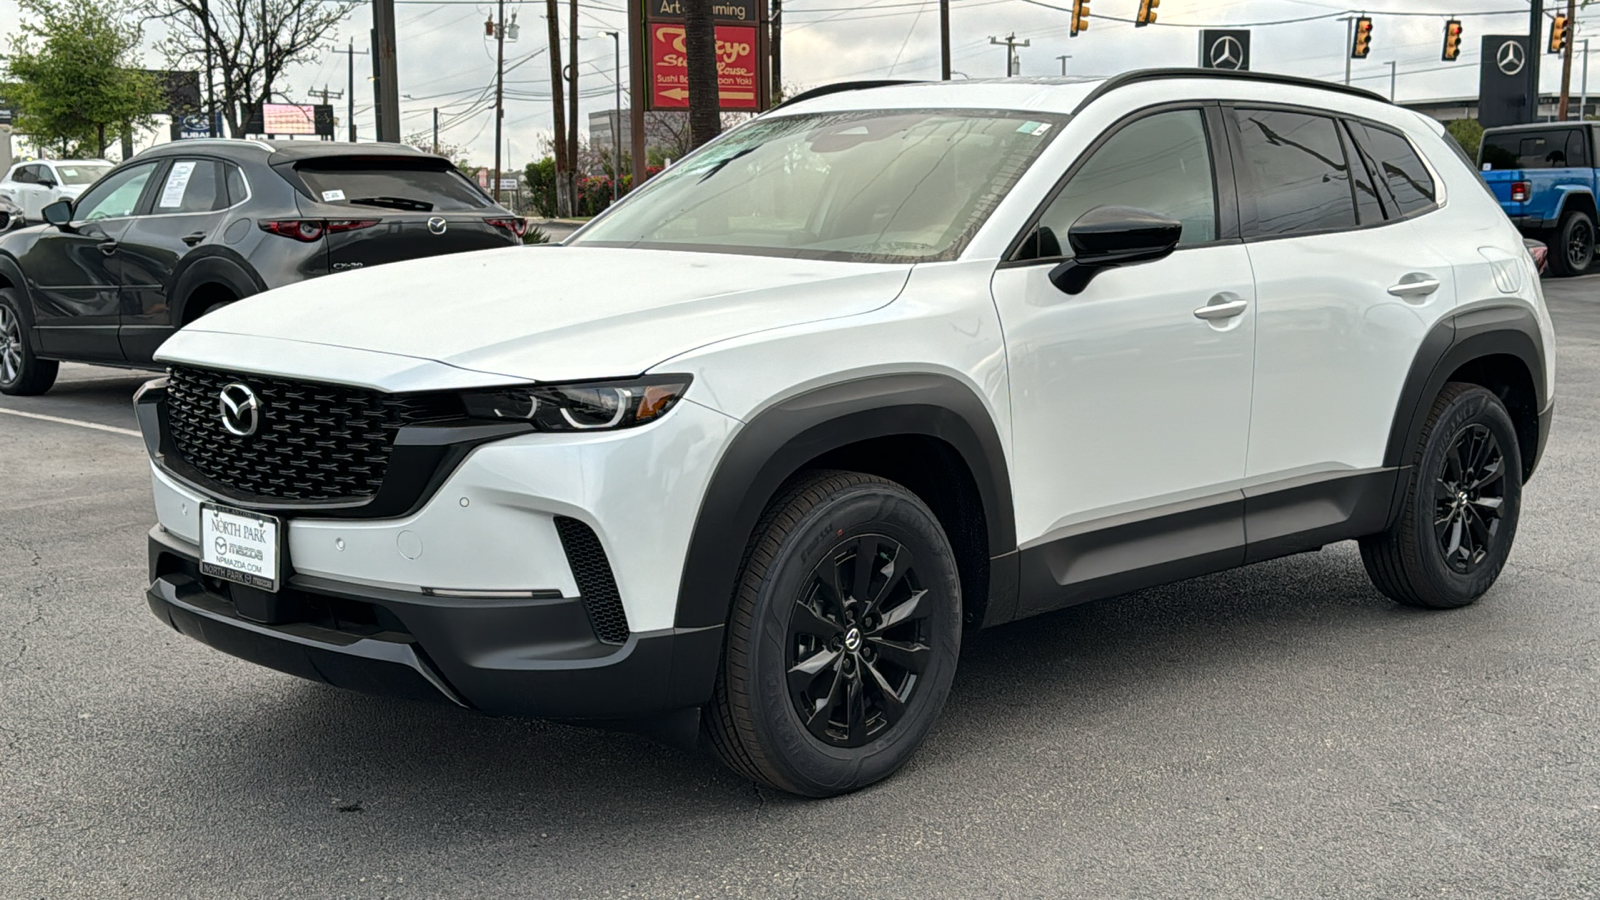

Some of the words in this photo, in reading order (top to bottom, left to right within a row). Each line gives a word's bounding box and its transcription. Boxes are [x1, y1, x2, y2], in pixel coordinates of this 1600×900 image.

[660, 0, 681, 14] Art
[657, 74, 678, 82] Sushi
[735, 77, 753, 85] Yaki
[211, 518, 241, 538] NORTH
[243, 525, 267, 543] PARK
[203, 563, 226, 577] NORTH
[226, 569, 244, 582] PARK
[215, 556, 262, 573] NPMAZDA.COM
